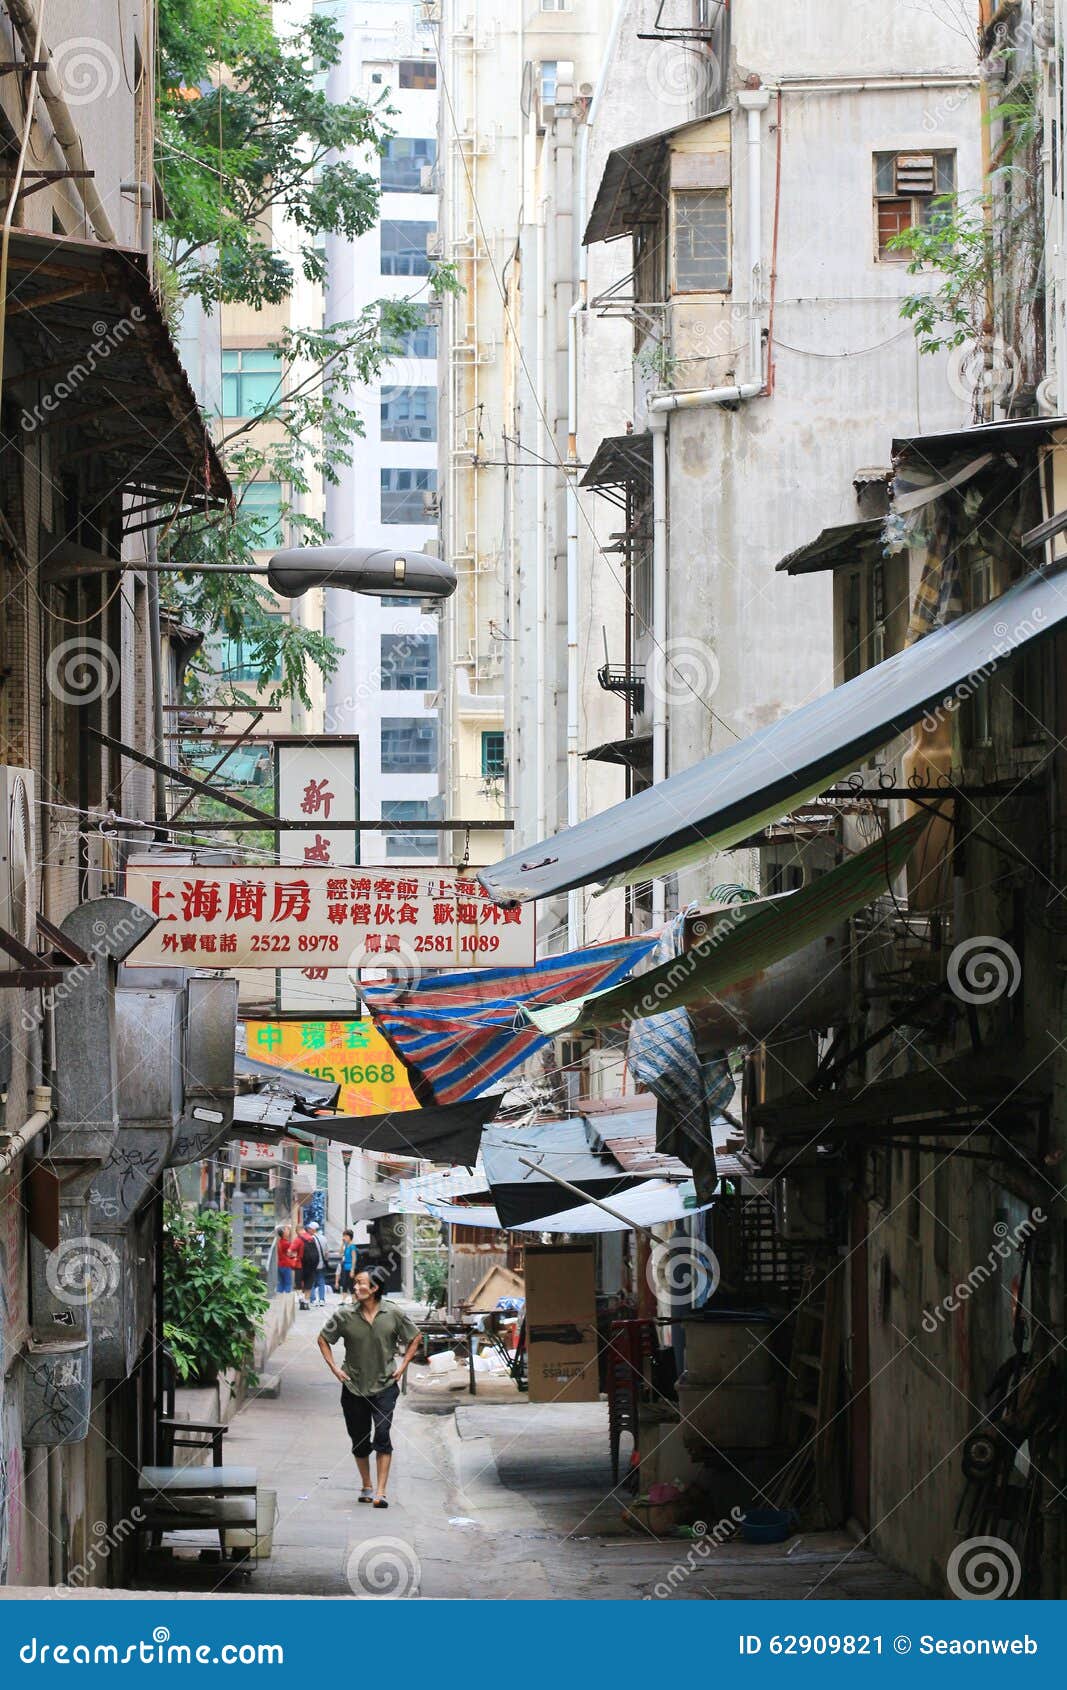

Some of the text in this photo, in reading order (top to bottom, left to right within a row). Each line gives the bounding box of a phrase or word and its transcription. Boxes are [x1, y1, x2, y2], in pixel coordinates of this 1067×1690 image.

[326, 878, 419, 900] 經濟客飯
[151, 880, 310, 922] 上海廚房
[327, 903, 419, 925] 專營伙食
[161, 933, 238, 953] 外賣電話
[250, 935, 290, 952] 2522
[298, 935, 339, 952] 8978
[414, 935, 454, 952] 2581
[461, 935, 500, 952] 1089
[342, 1065, 396, 1084] 1668
